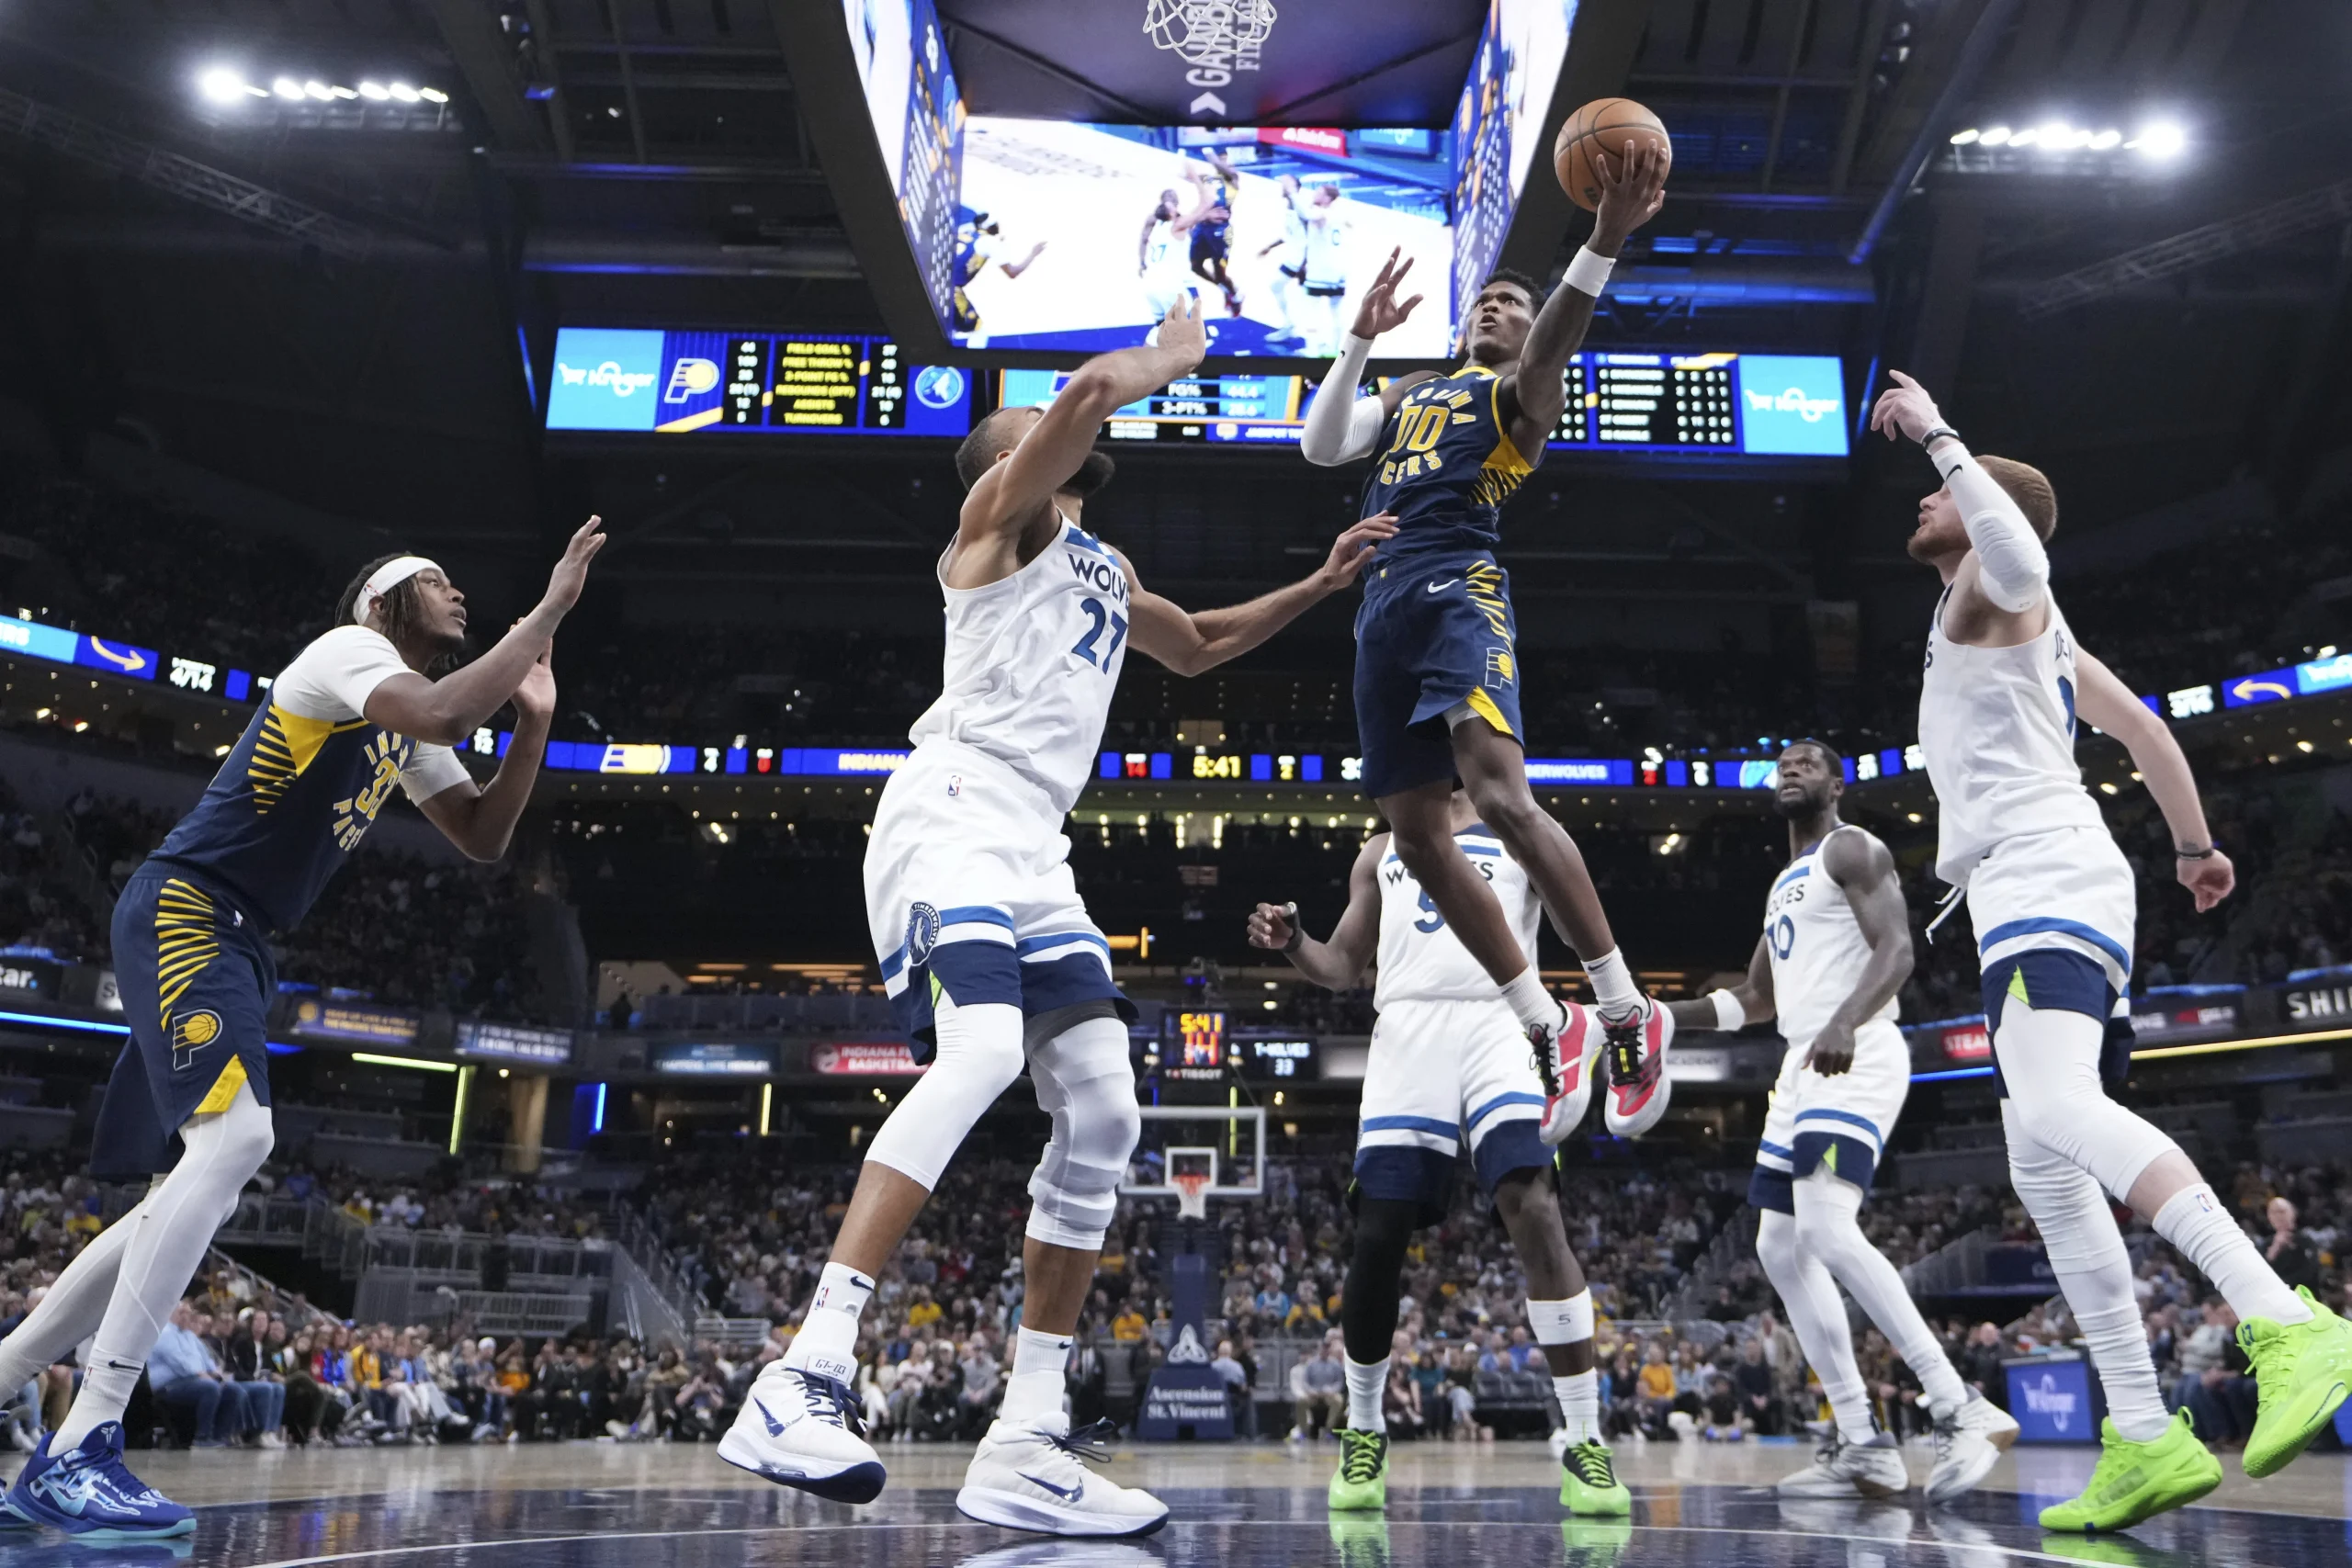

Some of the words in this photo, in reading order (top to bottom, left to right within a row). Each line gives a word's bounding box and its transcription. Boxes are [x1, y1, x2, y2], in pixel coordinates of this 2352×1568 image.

[1070, 597, 1129, 675] 27
[1125, 762, 1148, 778] 14
[1193, 755, 1241, 779] 5:41
[1180, 1012, 1223, 1034] 5:41
[848, 1057, 929, 1071] BASKETBA
[1557, 1313, 1571, 1325] 5
[1148, 1385, 1225, 1402] Ascension
[1168, 1403, 1227, 1420] Vincent
